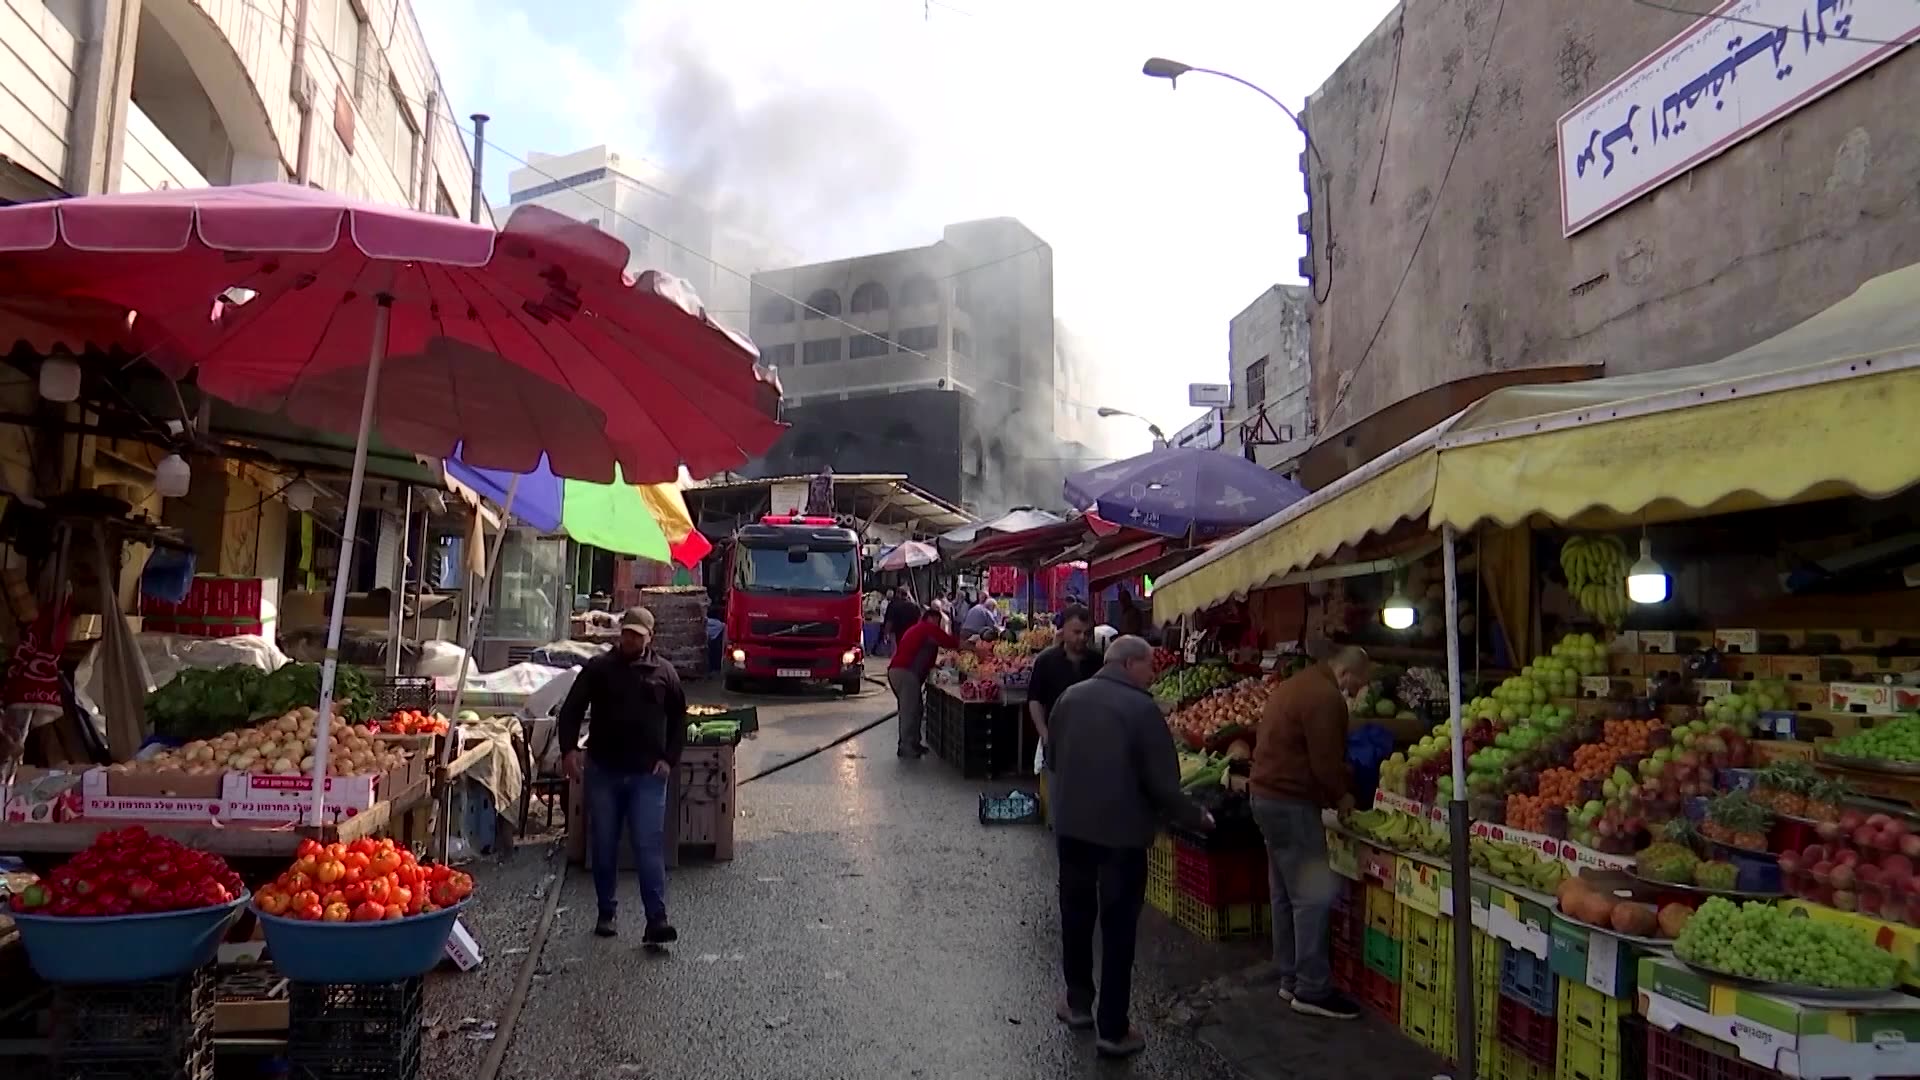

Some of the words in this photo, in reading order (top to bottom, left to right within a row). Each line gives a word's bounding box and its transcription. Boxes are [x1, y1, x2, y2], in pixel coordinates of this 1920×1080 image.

[1577, 104, 1641, 178] مركز
[1652, 25, 1793, 146] التصفية
[153, 800, 174, 810] שלג
